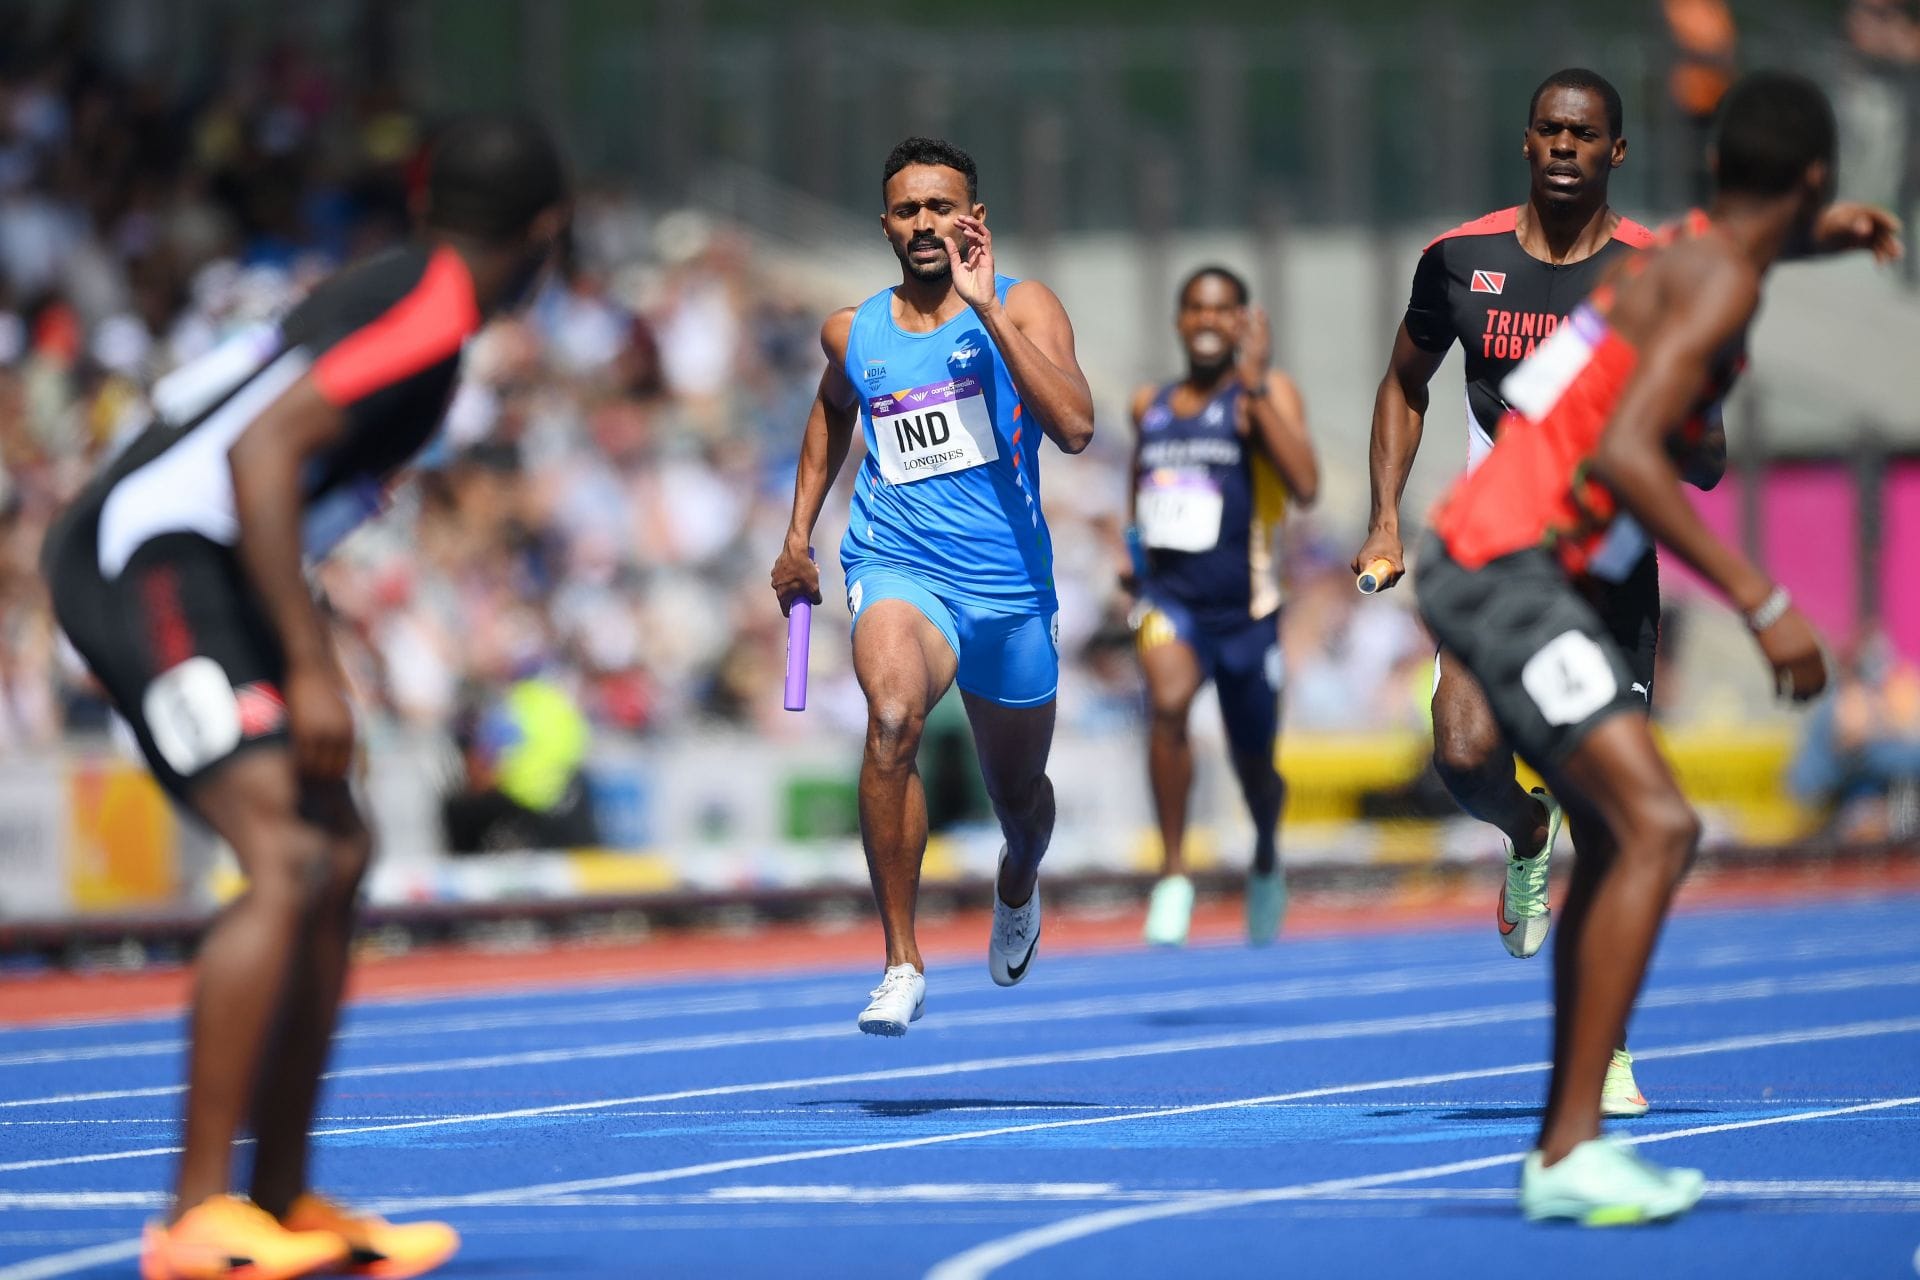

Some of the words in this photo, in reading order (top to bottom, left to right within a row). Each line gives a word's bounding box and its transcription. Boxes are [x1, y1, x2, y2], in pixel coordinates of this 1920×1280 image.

[1486, 309, 1573, 337] TRINIDA
[894, 411, 950, 453] IND
[903, 448, 964, 471] LONGINES
